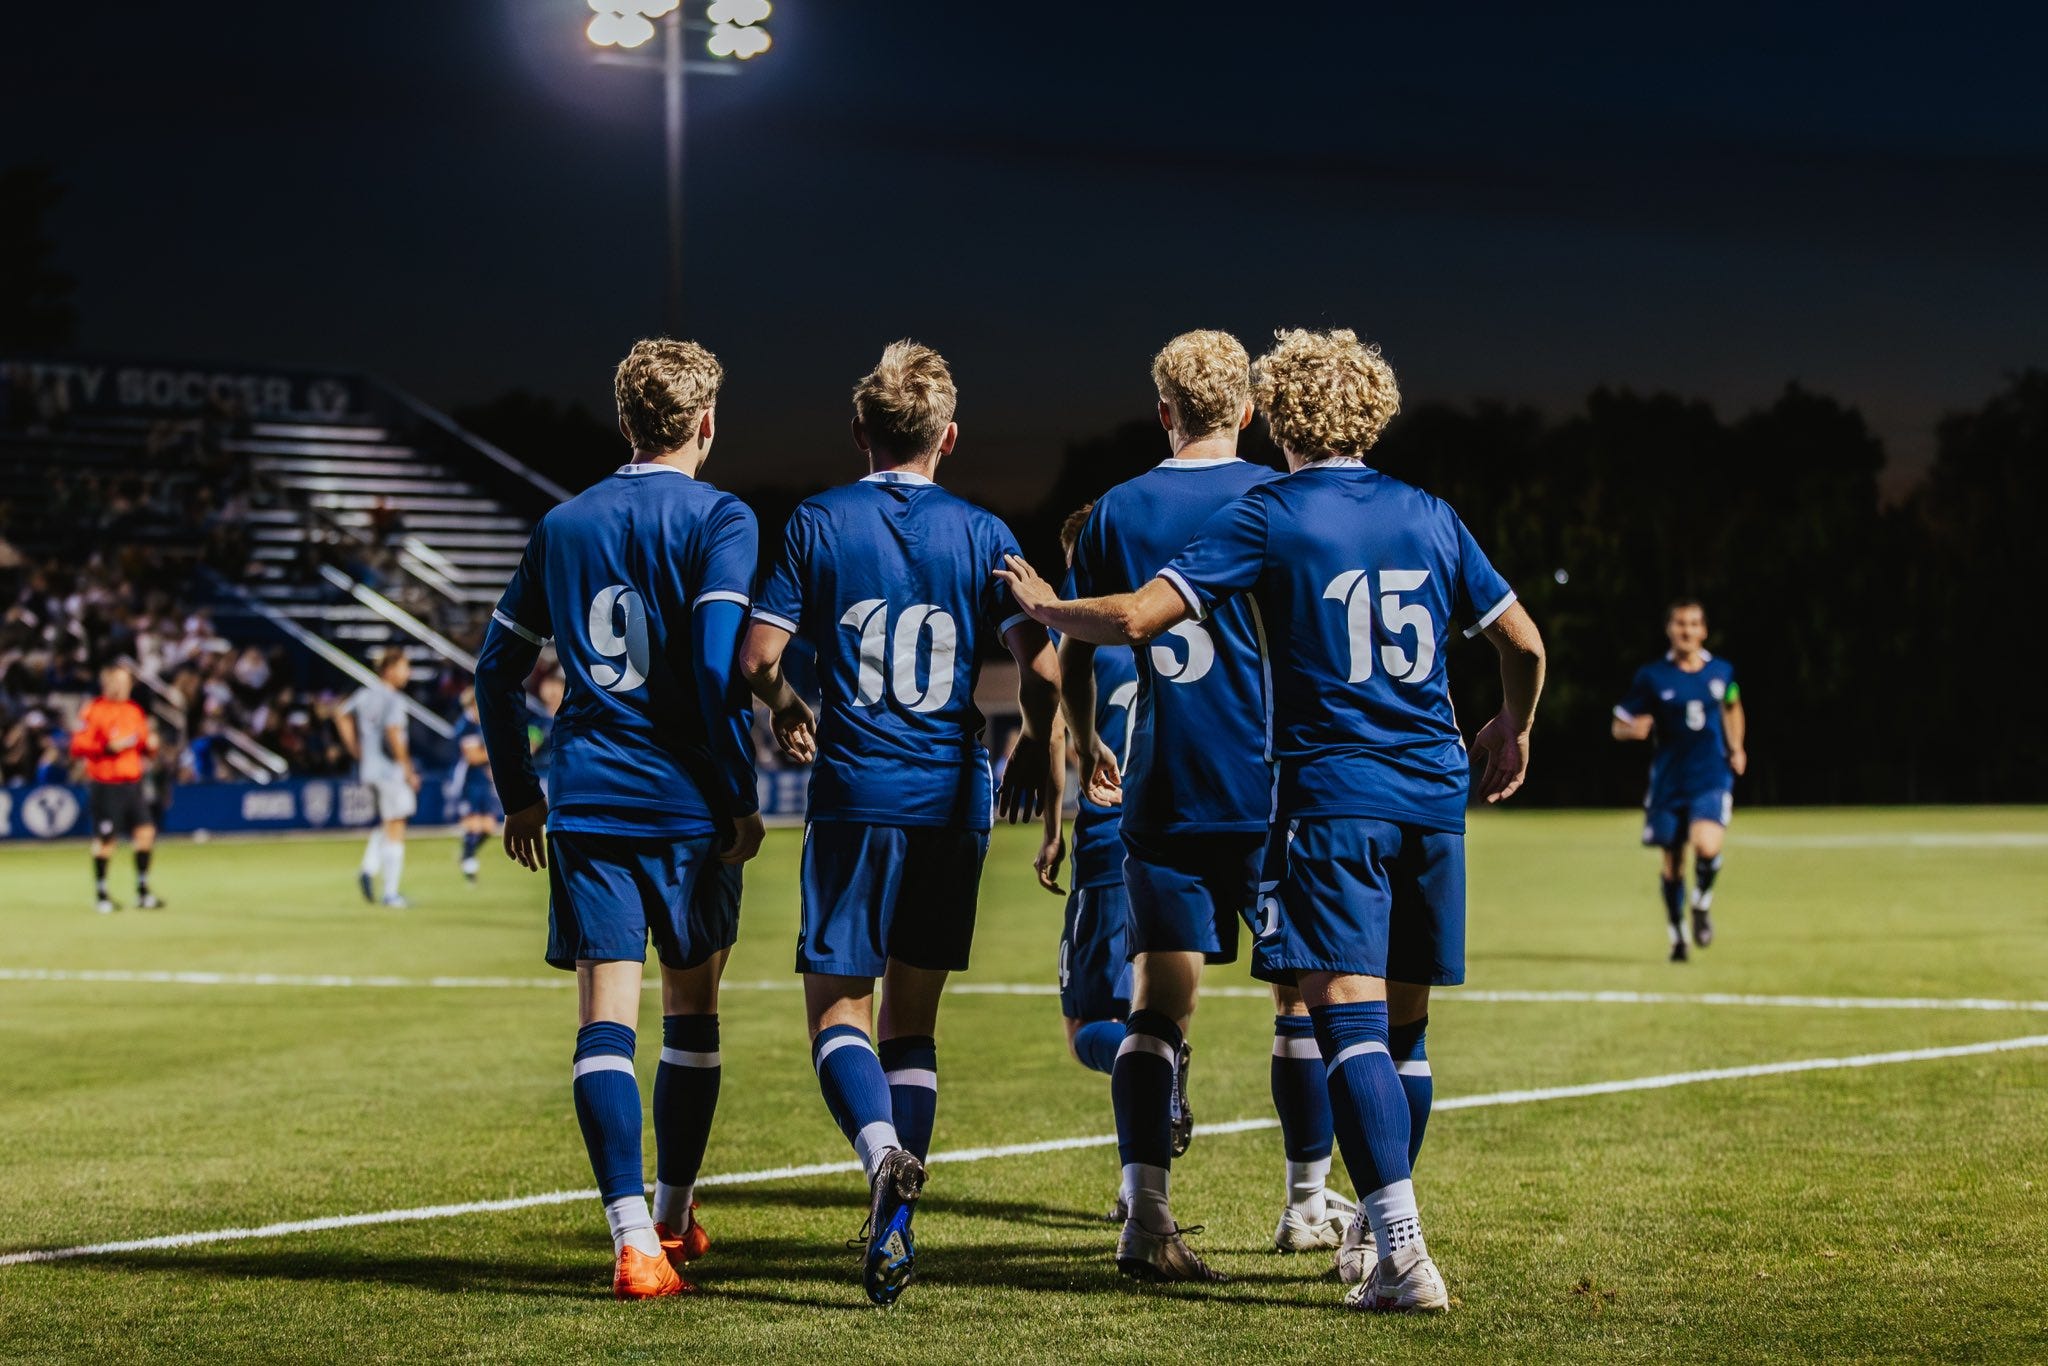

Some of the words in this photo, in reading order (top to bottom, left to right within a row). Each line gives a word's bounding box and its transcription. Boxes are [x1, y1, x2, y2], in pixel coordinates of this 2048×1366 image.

[589, 584, 650, 693] 9
[840, 598, 957, 713] 10
[1322, 569, 1435, 684] 15
